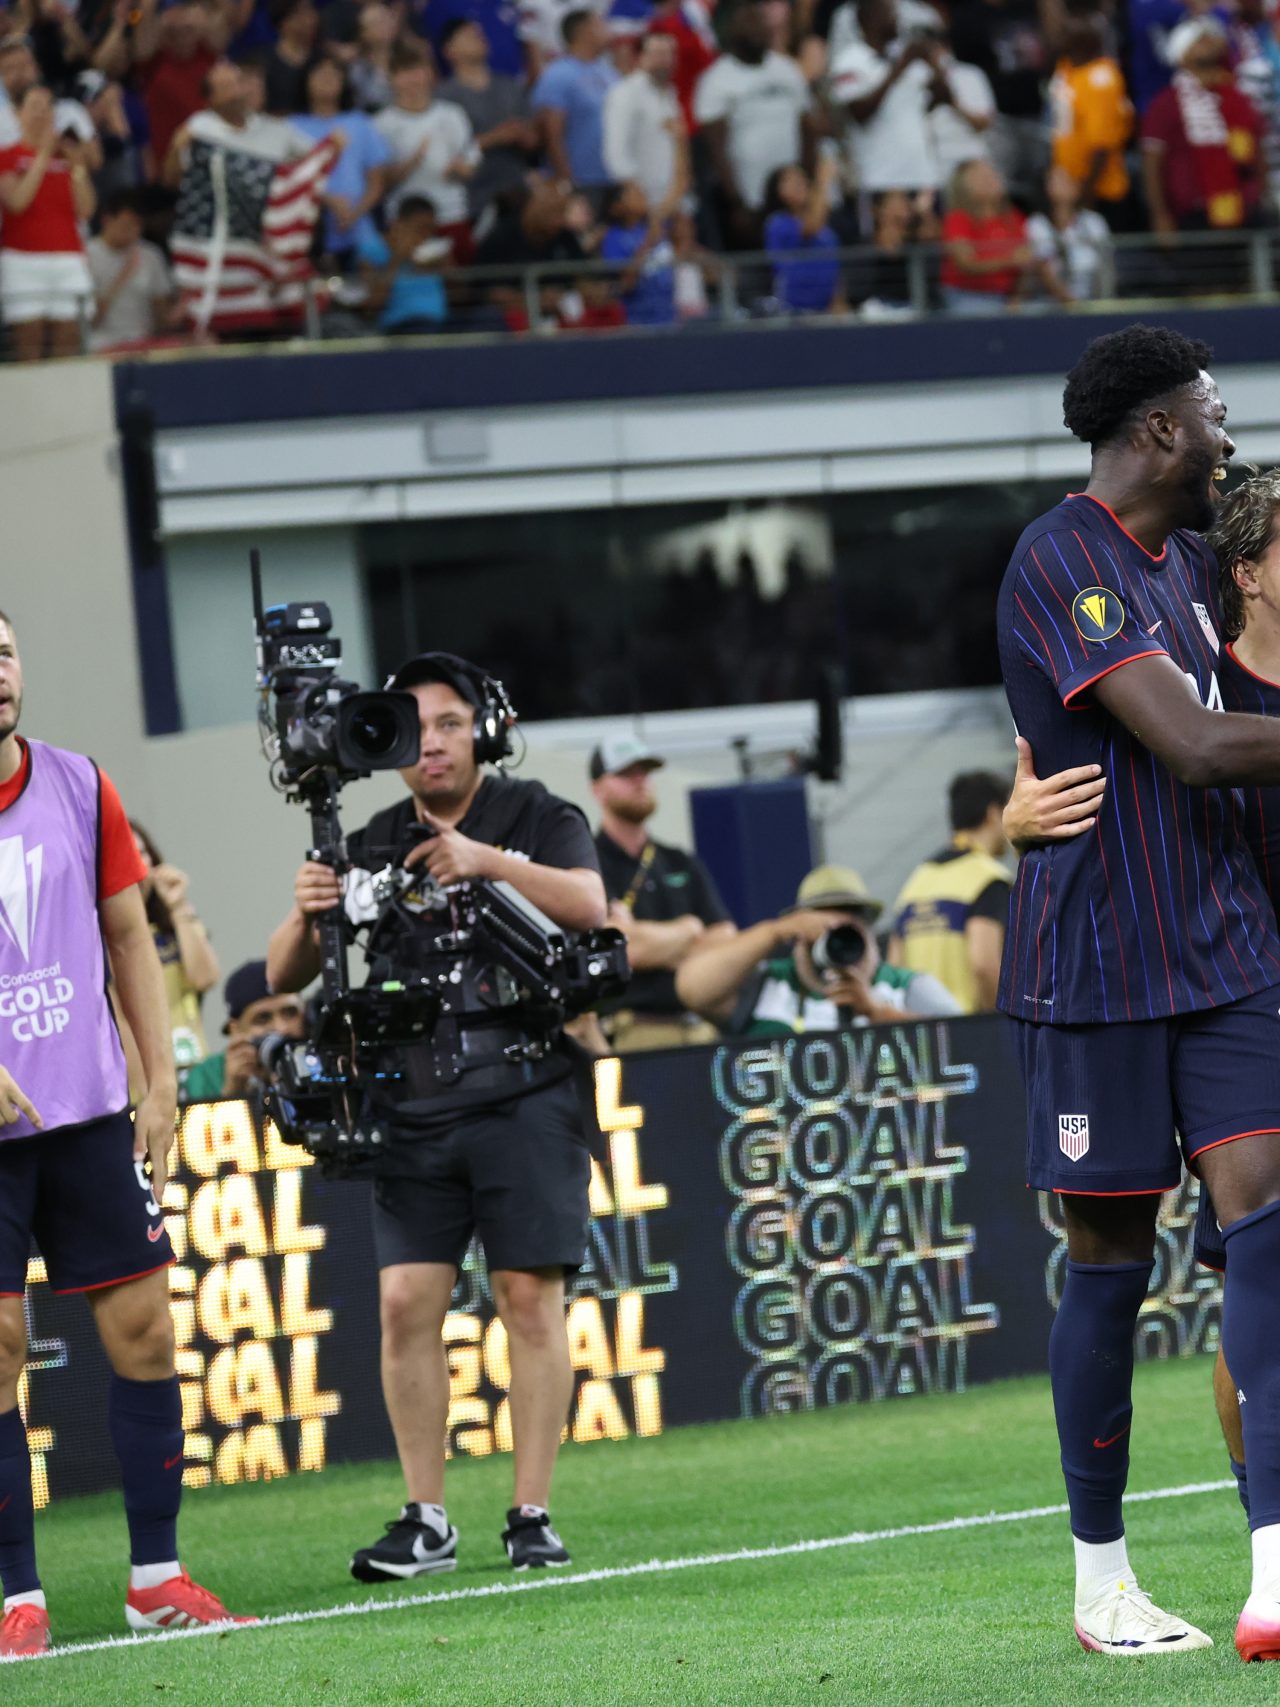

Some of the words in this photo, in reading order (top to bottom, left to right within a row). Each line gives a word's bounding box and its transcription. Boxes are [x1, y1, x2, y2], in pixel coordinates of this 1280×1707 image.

[0, 961, 61, 989] Concacaf
[0, 976, 75, 1017] GOLD
[11, 1006, 71, 1043] CUP
[711, 1022, 979, 1121] GOAL
[718, 1097, 970, 1203] GOAL
[1061, 1117, 1087, 1135] USA
[725, 1176, 977, 1282] GOAL
[734, 1254, 1000, 1363] GOAL
